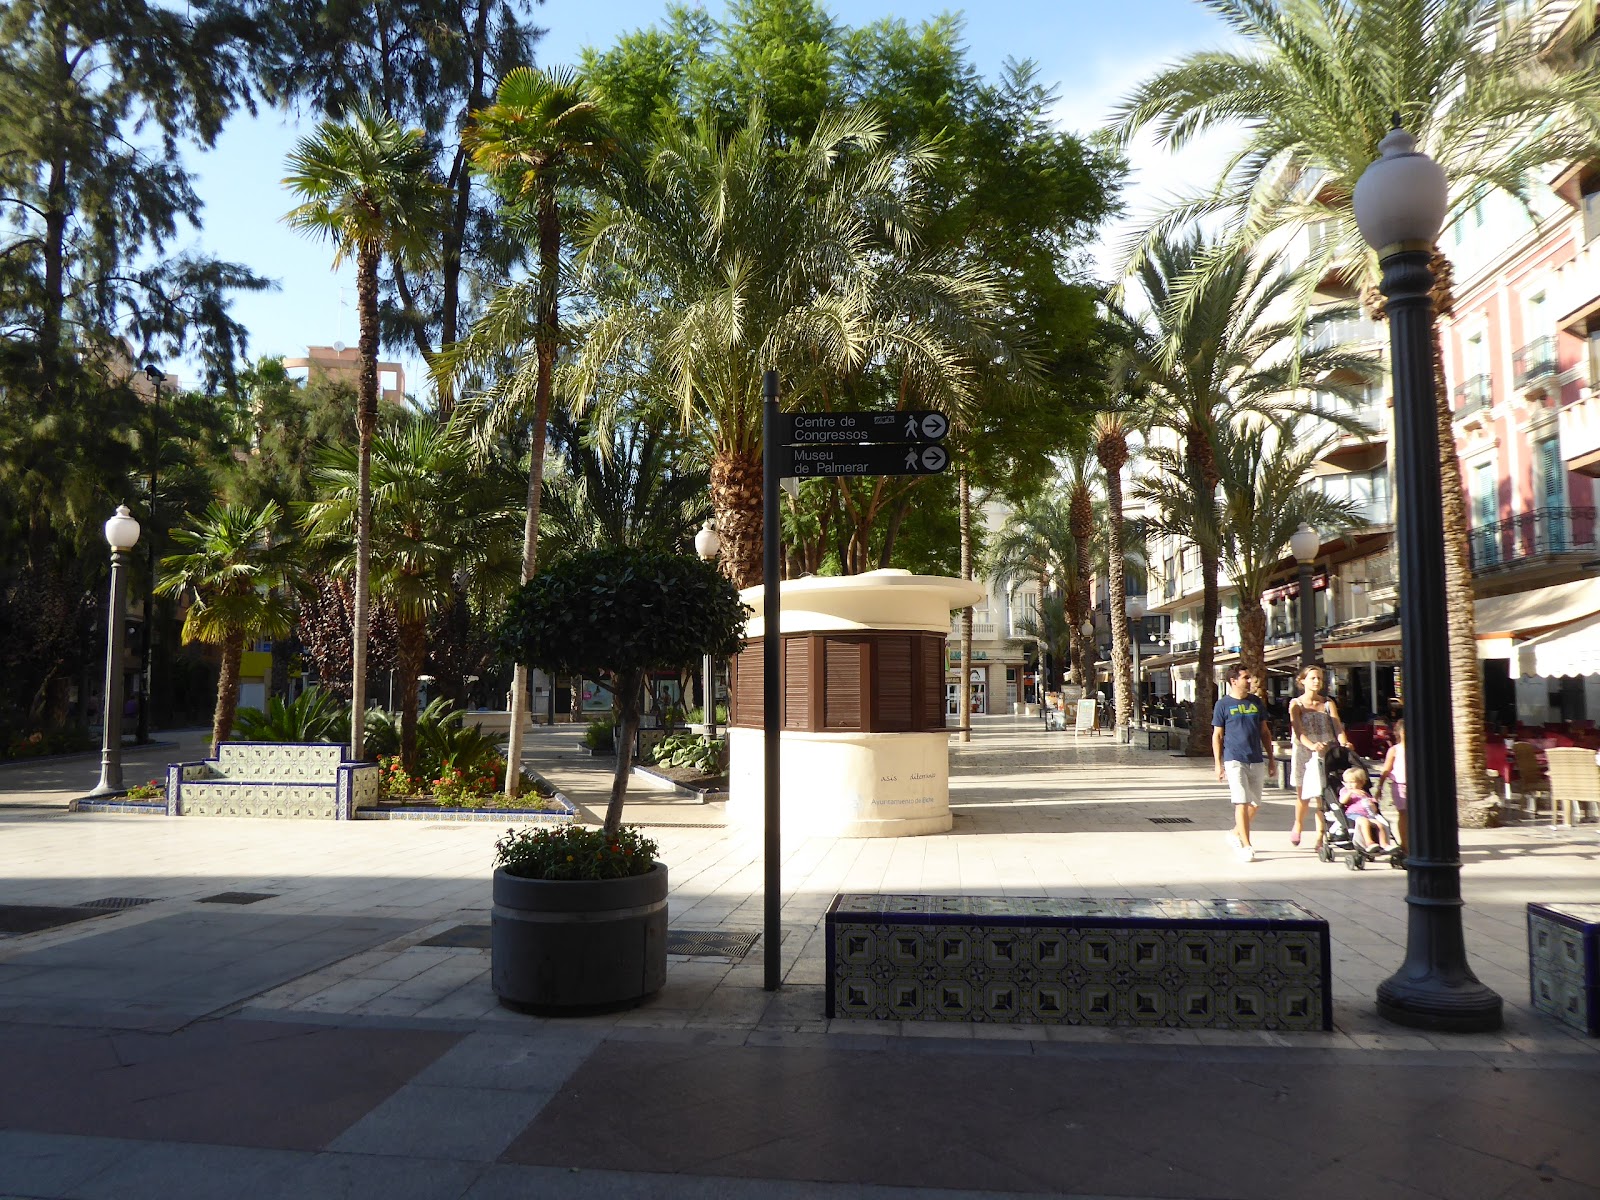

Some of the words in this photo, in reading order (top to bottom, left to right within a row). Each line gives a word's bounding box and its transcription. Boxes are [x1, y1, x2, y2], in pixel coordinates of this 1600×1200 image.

[794, 416, 836, 428] Centre
[840, 416, 856, 427] de
[794, 430, 868, 442] Congressos
[794, 450, 834, 461] Museu
[794, 463, 810, 474] de
[817, 462, 869, 474] Palmerar
[1229, 703, 1259, 716] FILA
[871, 798, 914, 806] Ayuntamiento
